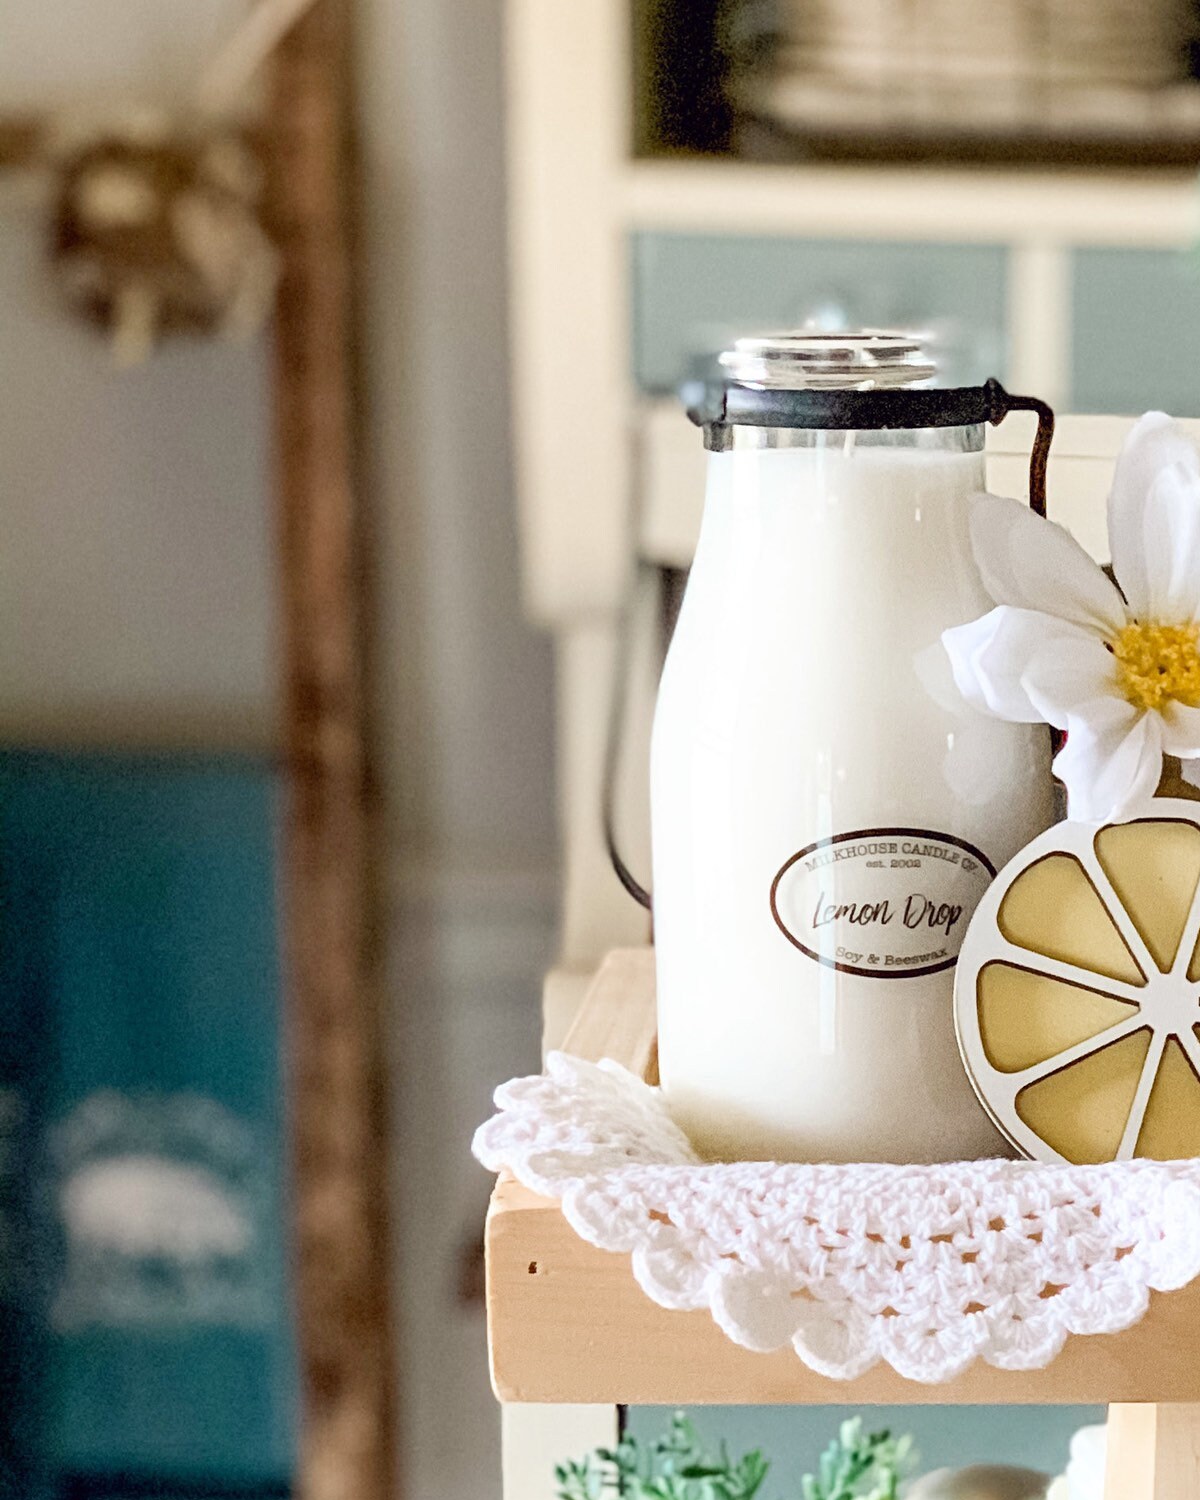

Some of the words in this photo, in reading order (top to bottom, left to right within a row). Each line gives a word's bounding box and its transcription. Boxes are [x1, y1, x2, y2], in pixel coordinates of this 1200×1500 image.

[866, 860, 886, 869] est.
[890, 859, 922, 869] 2002
[902, 843, 960, 865] CANDLE
[812, 891, 895, 929] Lemon
[903, 893, 963, 936] Drop
[836, 946, 864, 964] Soy
[867, 953, 881, 965] &
[884, 947, 948, 966] Beeswax
